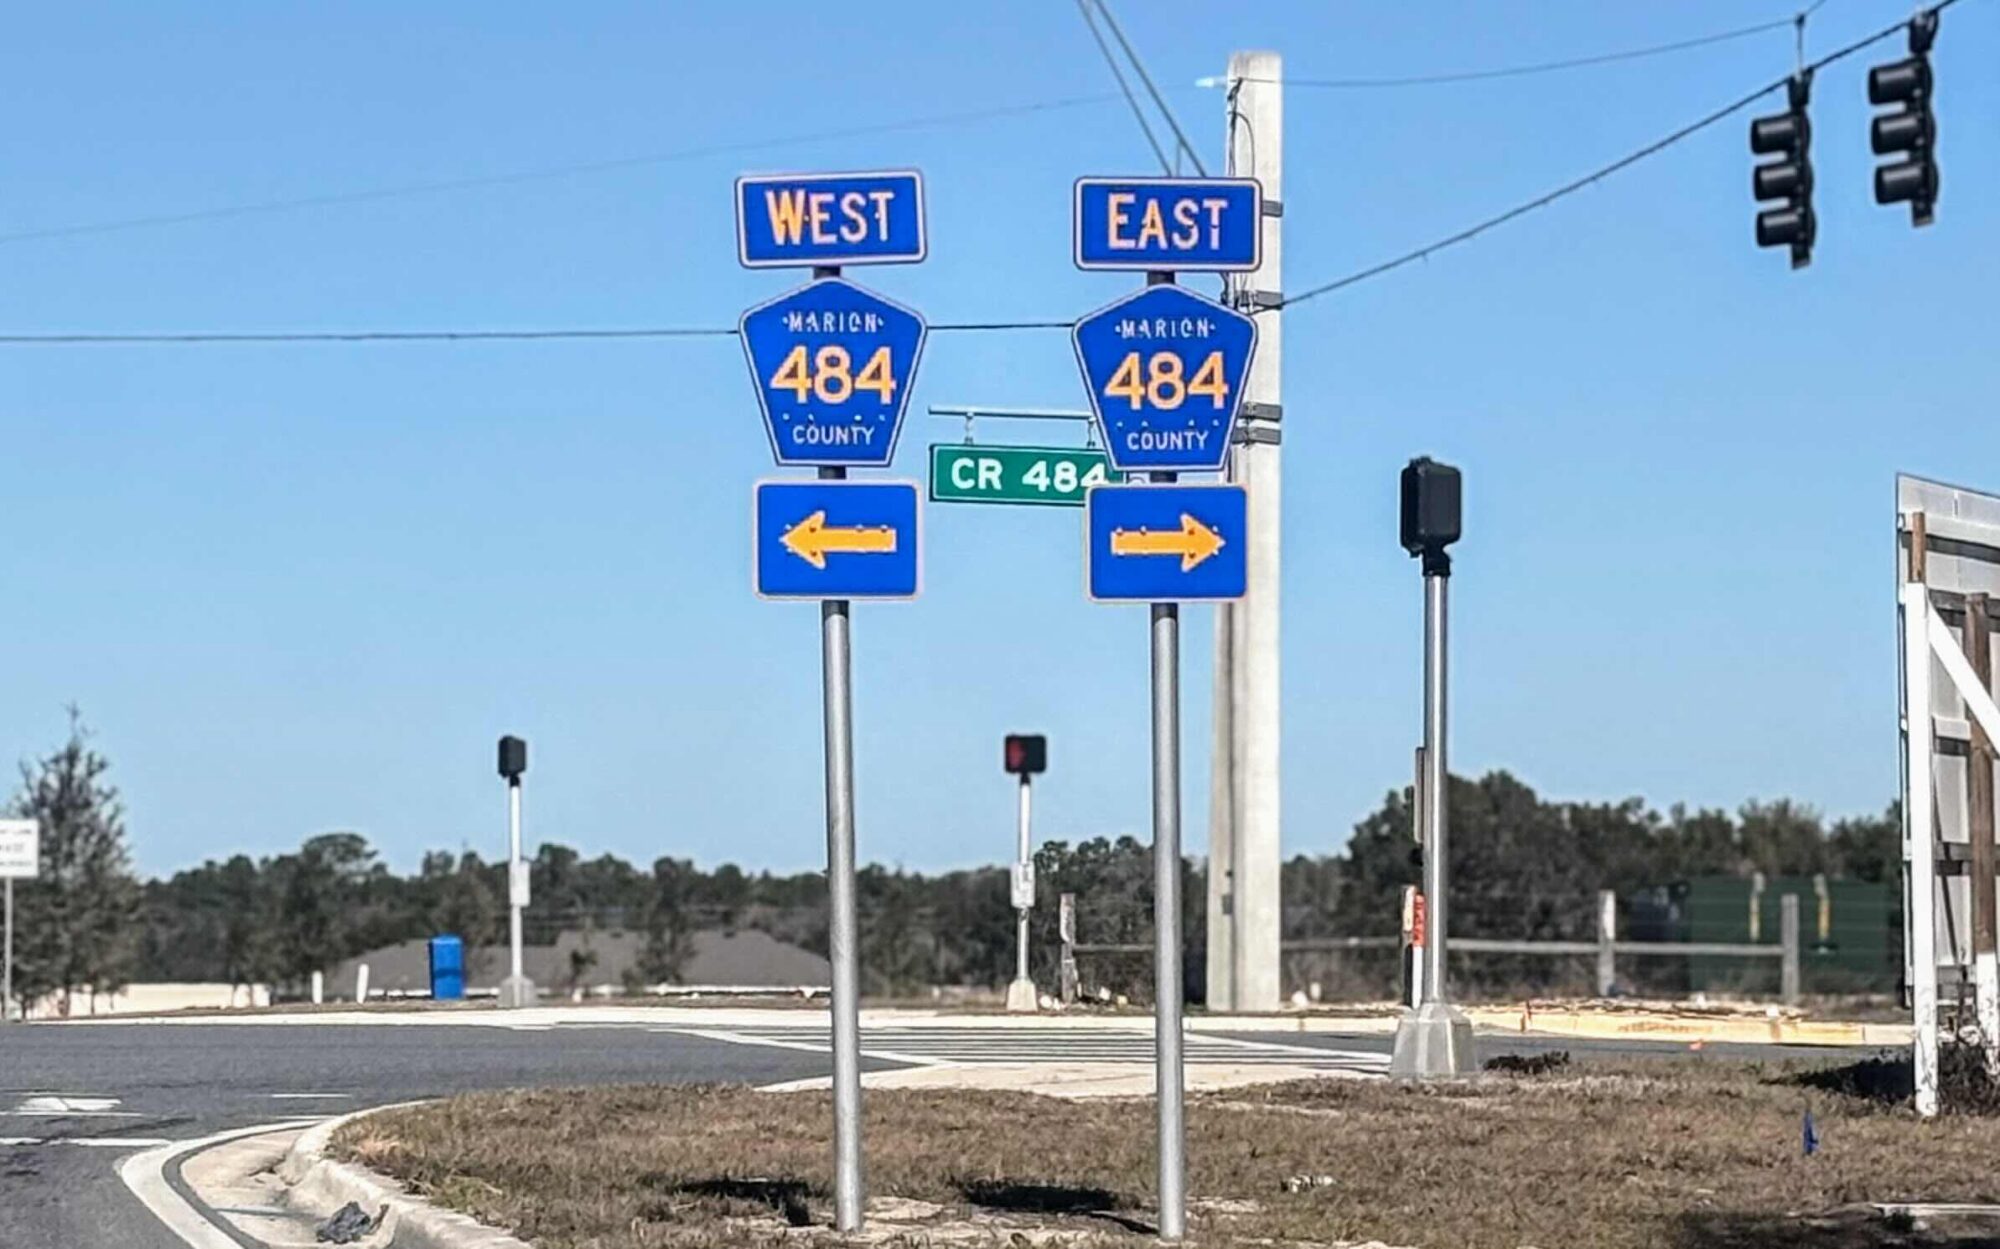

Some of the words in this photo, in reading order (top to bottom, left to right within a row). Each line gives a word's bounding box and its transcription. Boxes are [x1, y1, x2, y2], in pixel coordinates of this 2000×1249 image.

[765, 189, 895, 246] WEST
[1108, 192, 1228, 249] EAST
[788, 310, 878, 334] MARION
[1121, 317, 1210, 339] MARION
[770, 345, 897, 405] 484
[1104, 351, 1230, 410] 484
[792, 424, 875, 446] COUNTY
[1126, 430, 1210, 451] COUNTY
[951, 456, 1003, 490] CR
[1021, 460, 1109, 493] 484
